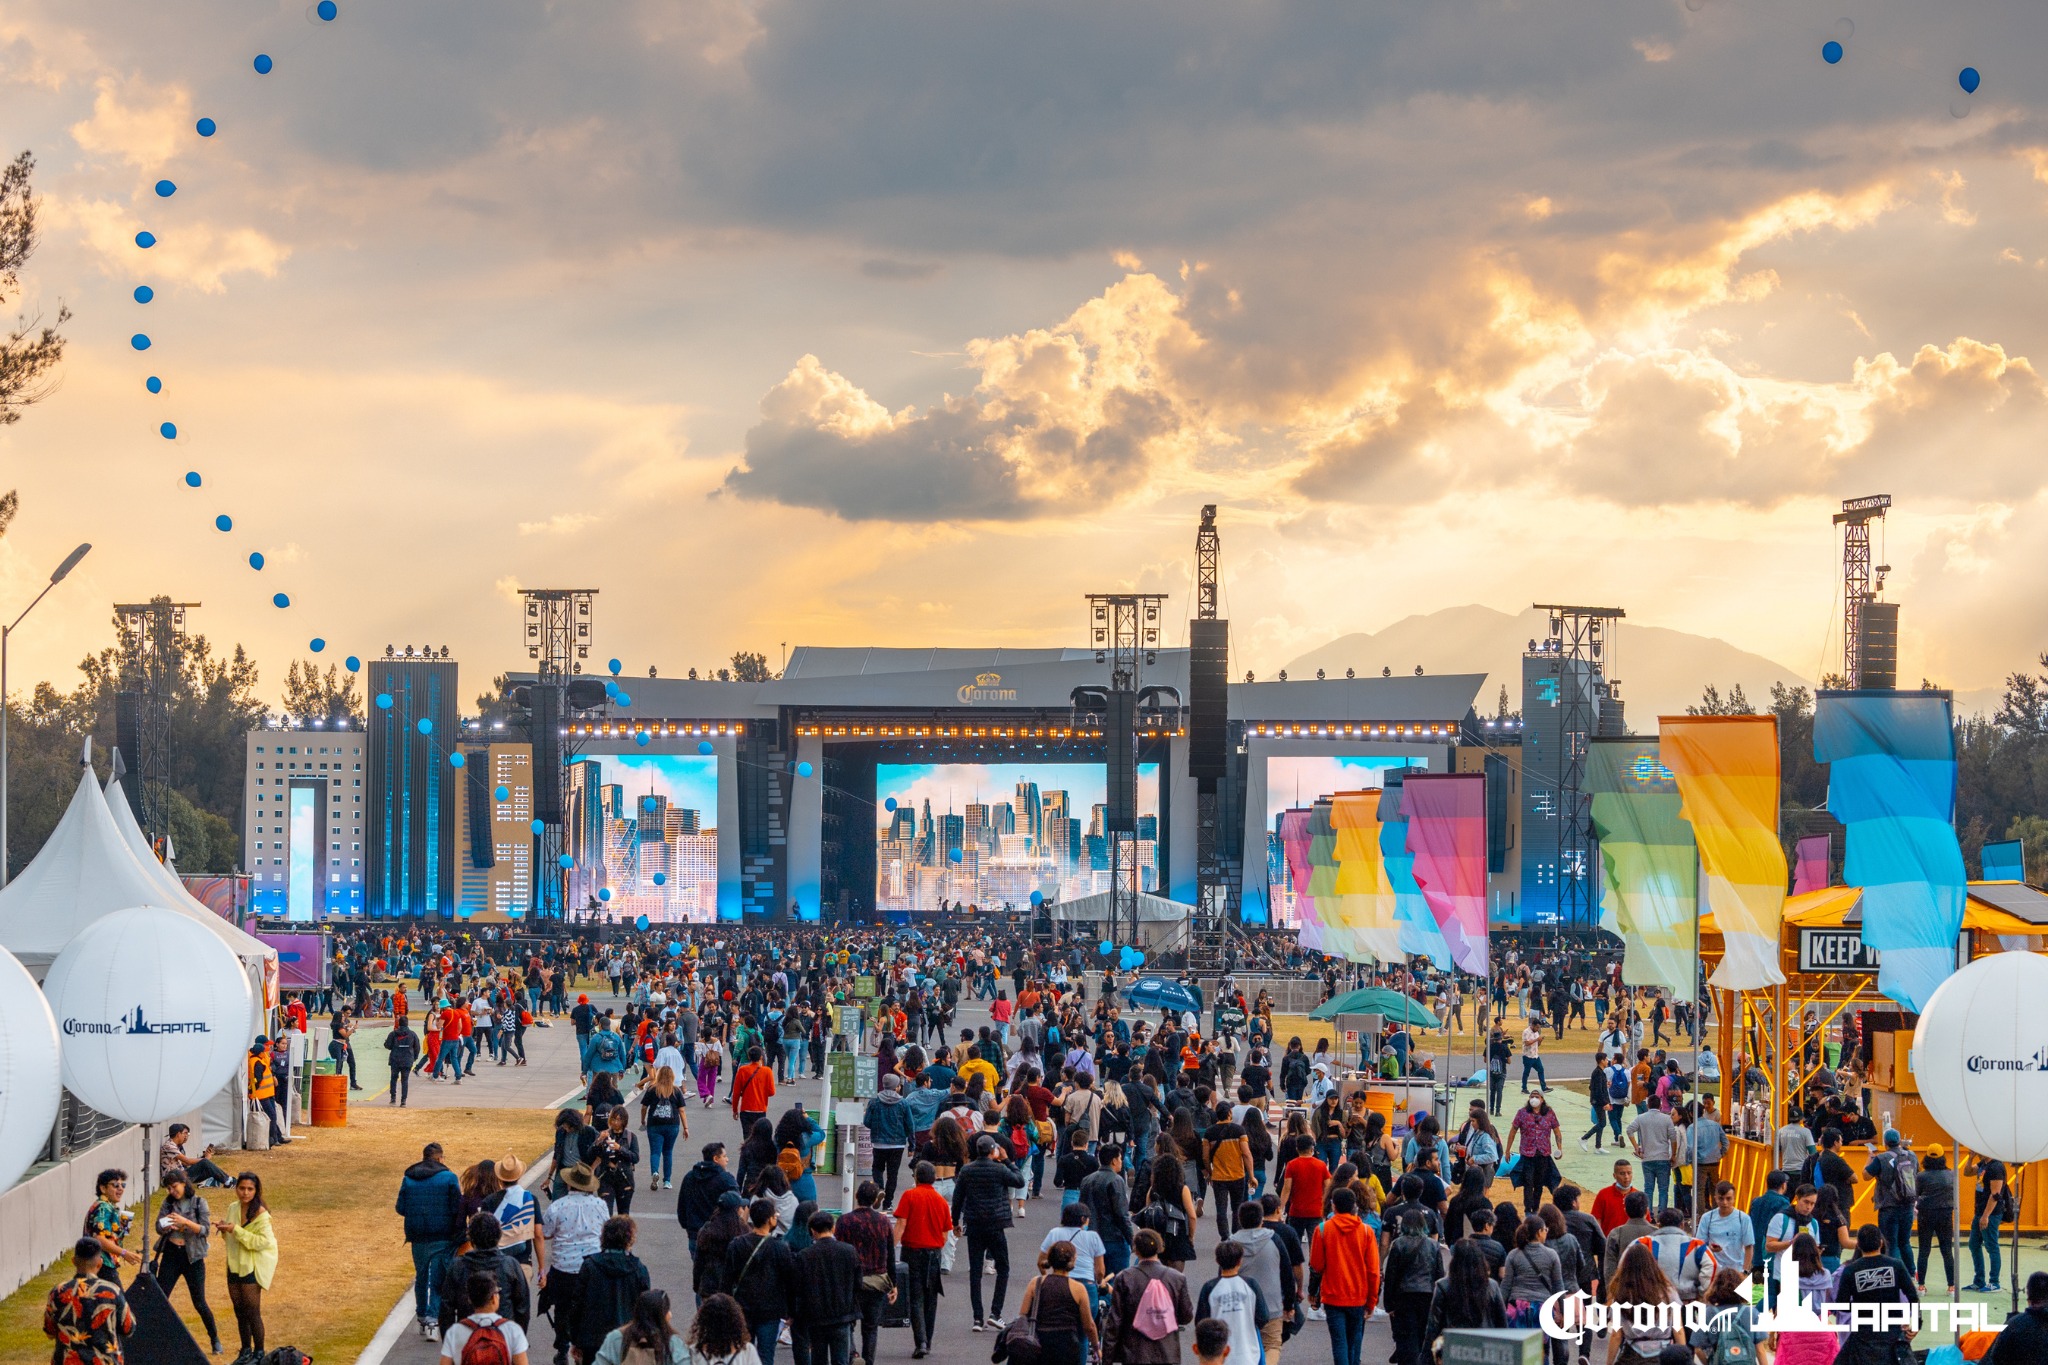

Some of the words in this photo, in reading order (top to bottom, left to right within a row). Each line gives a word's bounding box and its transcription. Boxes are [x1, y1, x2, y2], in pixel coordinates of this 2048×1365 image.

[957, 684, 1018, 706] Corona
[1812, 935, 1861, 965] KEEP
[63, 1017, 112, 1037] Corona
[151, 1022, 211, 1034] CAPITAL
[1967, 1055, 2024, 1074] Corona
